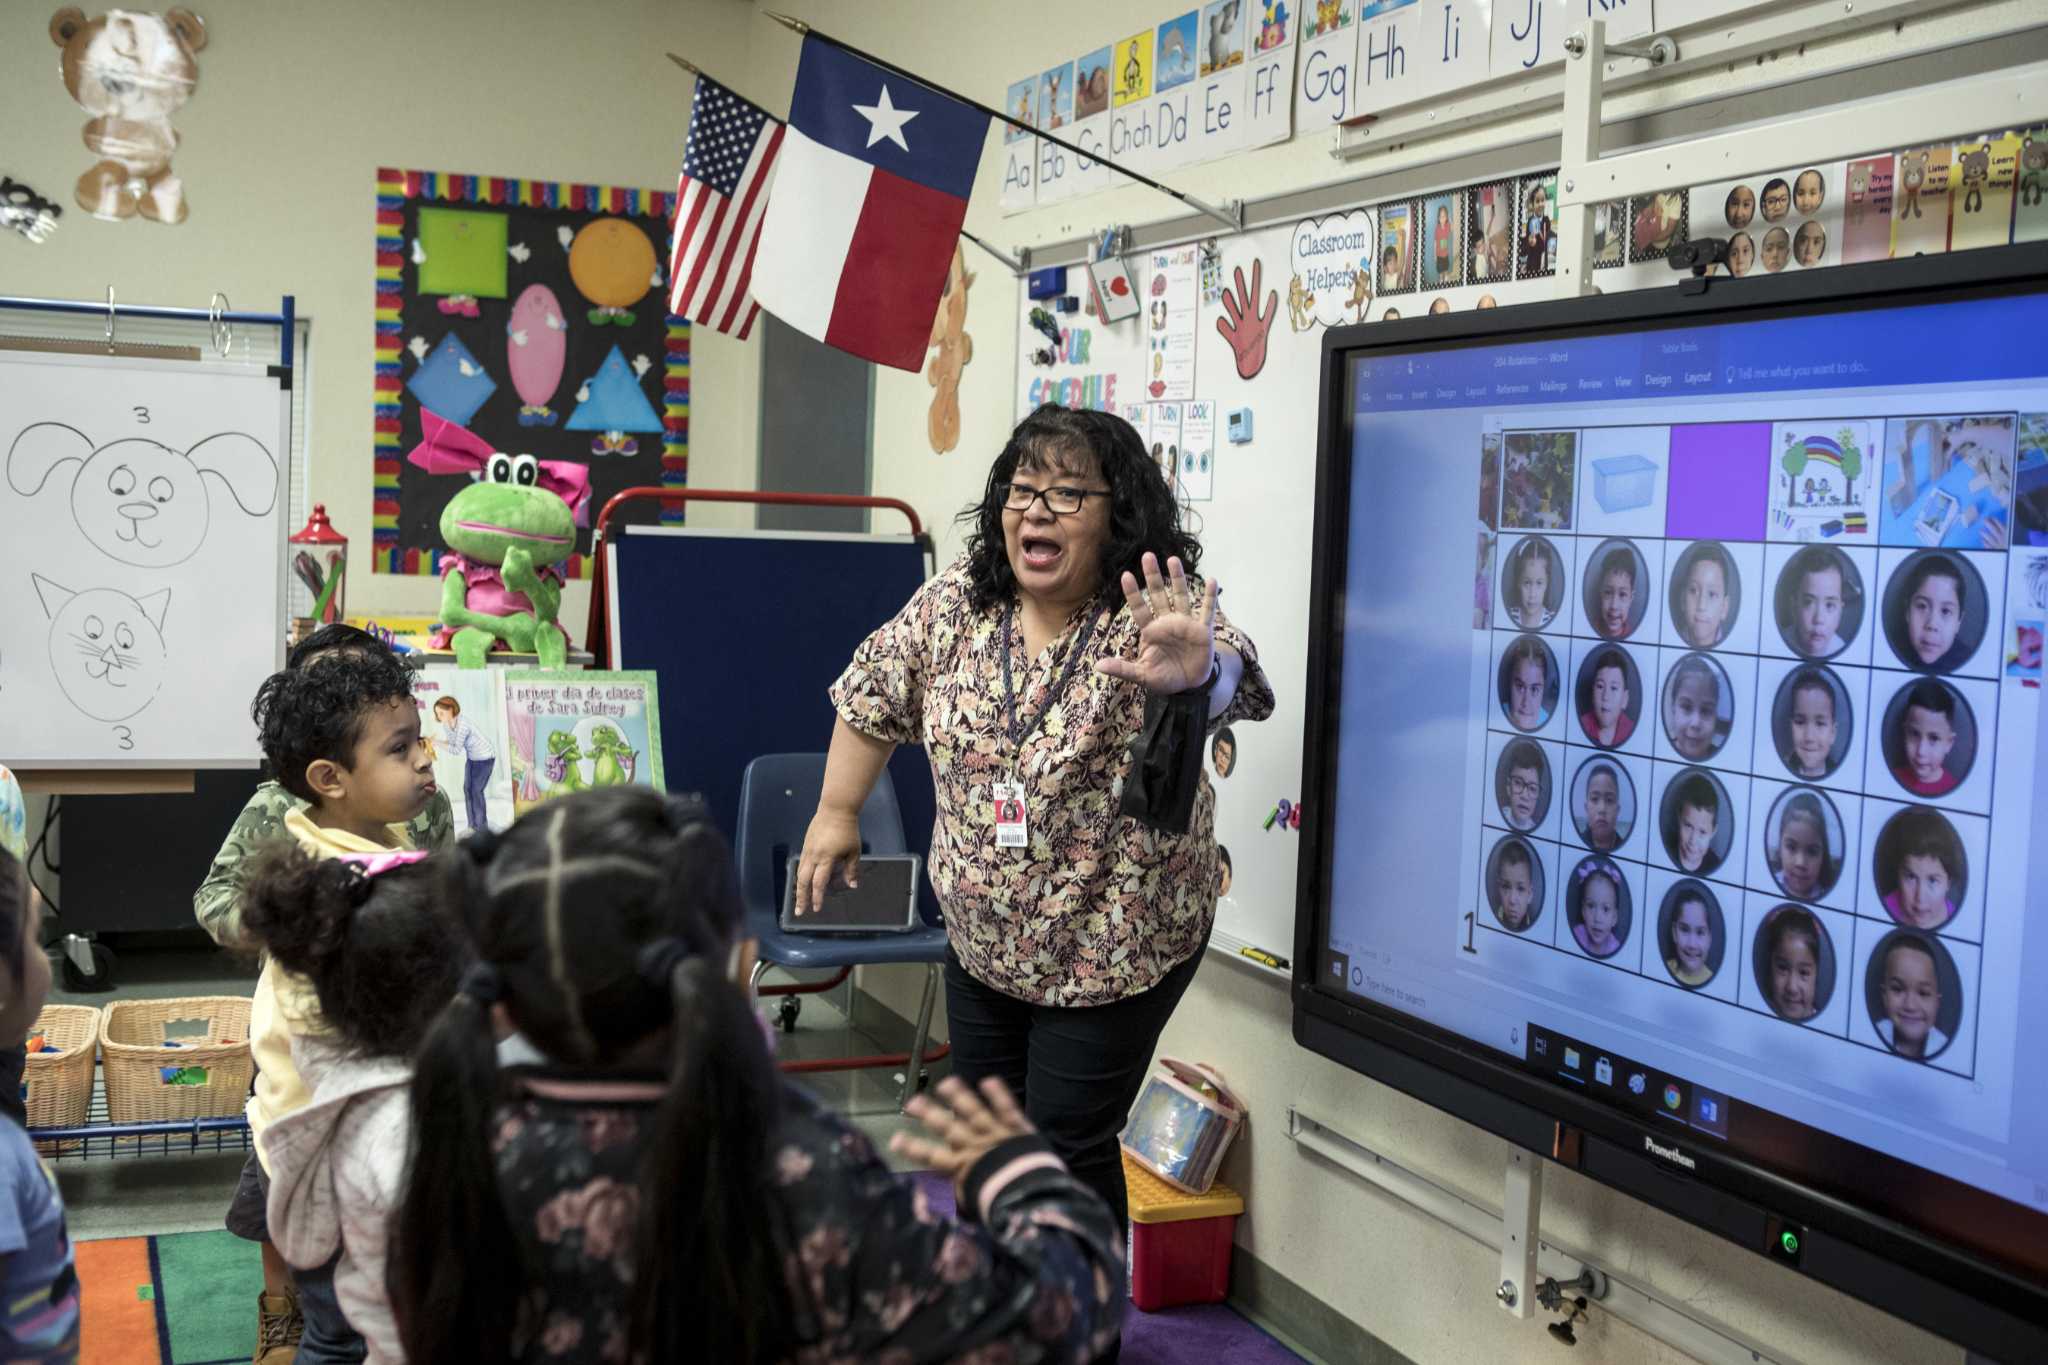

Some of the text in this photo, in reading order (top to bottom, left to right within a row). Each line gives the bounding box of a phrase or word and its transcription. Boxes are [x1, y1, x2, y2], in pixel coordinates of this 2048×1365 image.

[1442, 5, 1460, 62] Ii
[1367, 24, 1405, 85] Hh
[1255, 63, 1280, 120] Ff
[1304, 50, 1347, 121] Gg
[1157, 96, 1188, 149] Dd
[1205, 84, 1232, 134] Ee
[1040, 142, 1065, 184] Bb
[1076, 128, 1103, 171] Cc
[1004, 153, 1030, 192] Aa
[1299, 231, 1365, 257] Classroom
[1307, 267, 1357, 293] Helpers
[1058, 327, 1091, 365] OUR
[1645, 373, 1673, 388] Design
[1684, 370, 1712, 385] Layout
[133, 406, 151, 423] 3
[1188, 402, 1208, 419] LOOK
[527, 700, 544, 713] de
[548, 700, 577, 714] Sara
[587, 686, 603, 699] de
[606, 686, 645, 700] clases
[112, 725, 134, 750] 3
[1462, 911, 1477, 955] 1
[1645, 1135, 1696, 1170] Promethean
